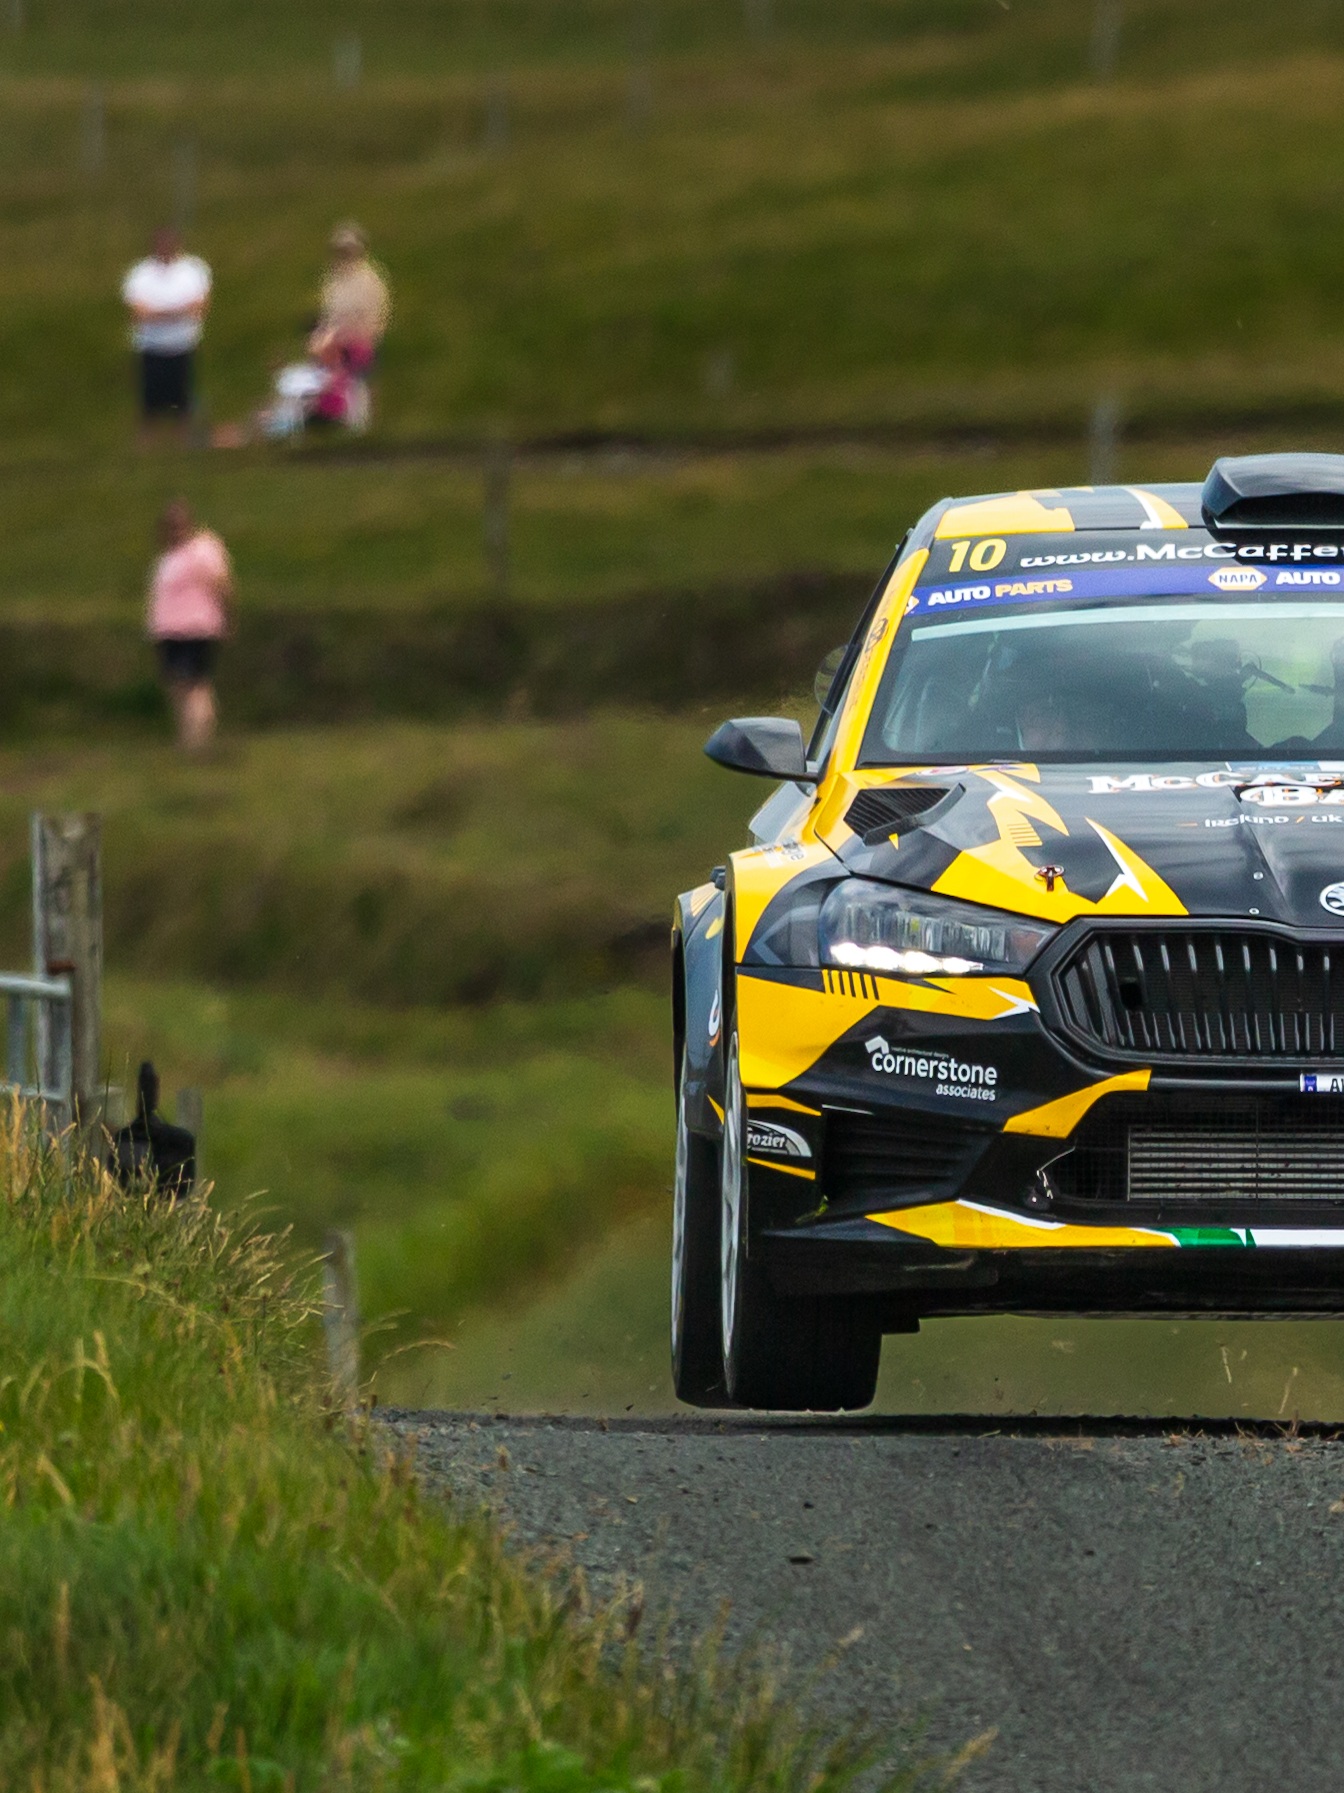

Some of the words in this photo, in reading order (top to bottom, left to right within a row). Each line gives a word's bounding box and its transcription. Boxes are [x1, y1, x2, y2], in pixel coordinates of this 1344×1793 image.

[949, 538, 1007, 572] 10
[1219, 574, 1258, 584] NAPA
[1276, 571, 1340, 585] AUTO
[928, 585, 990, 606] AUTO
[995, 579, 1073, 598] PARTS
[872, 1052, 998, 1085] cornerstone
[935, 1083, 996, 1102] associates
[747, 1126, 785, 1150] rozier
